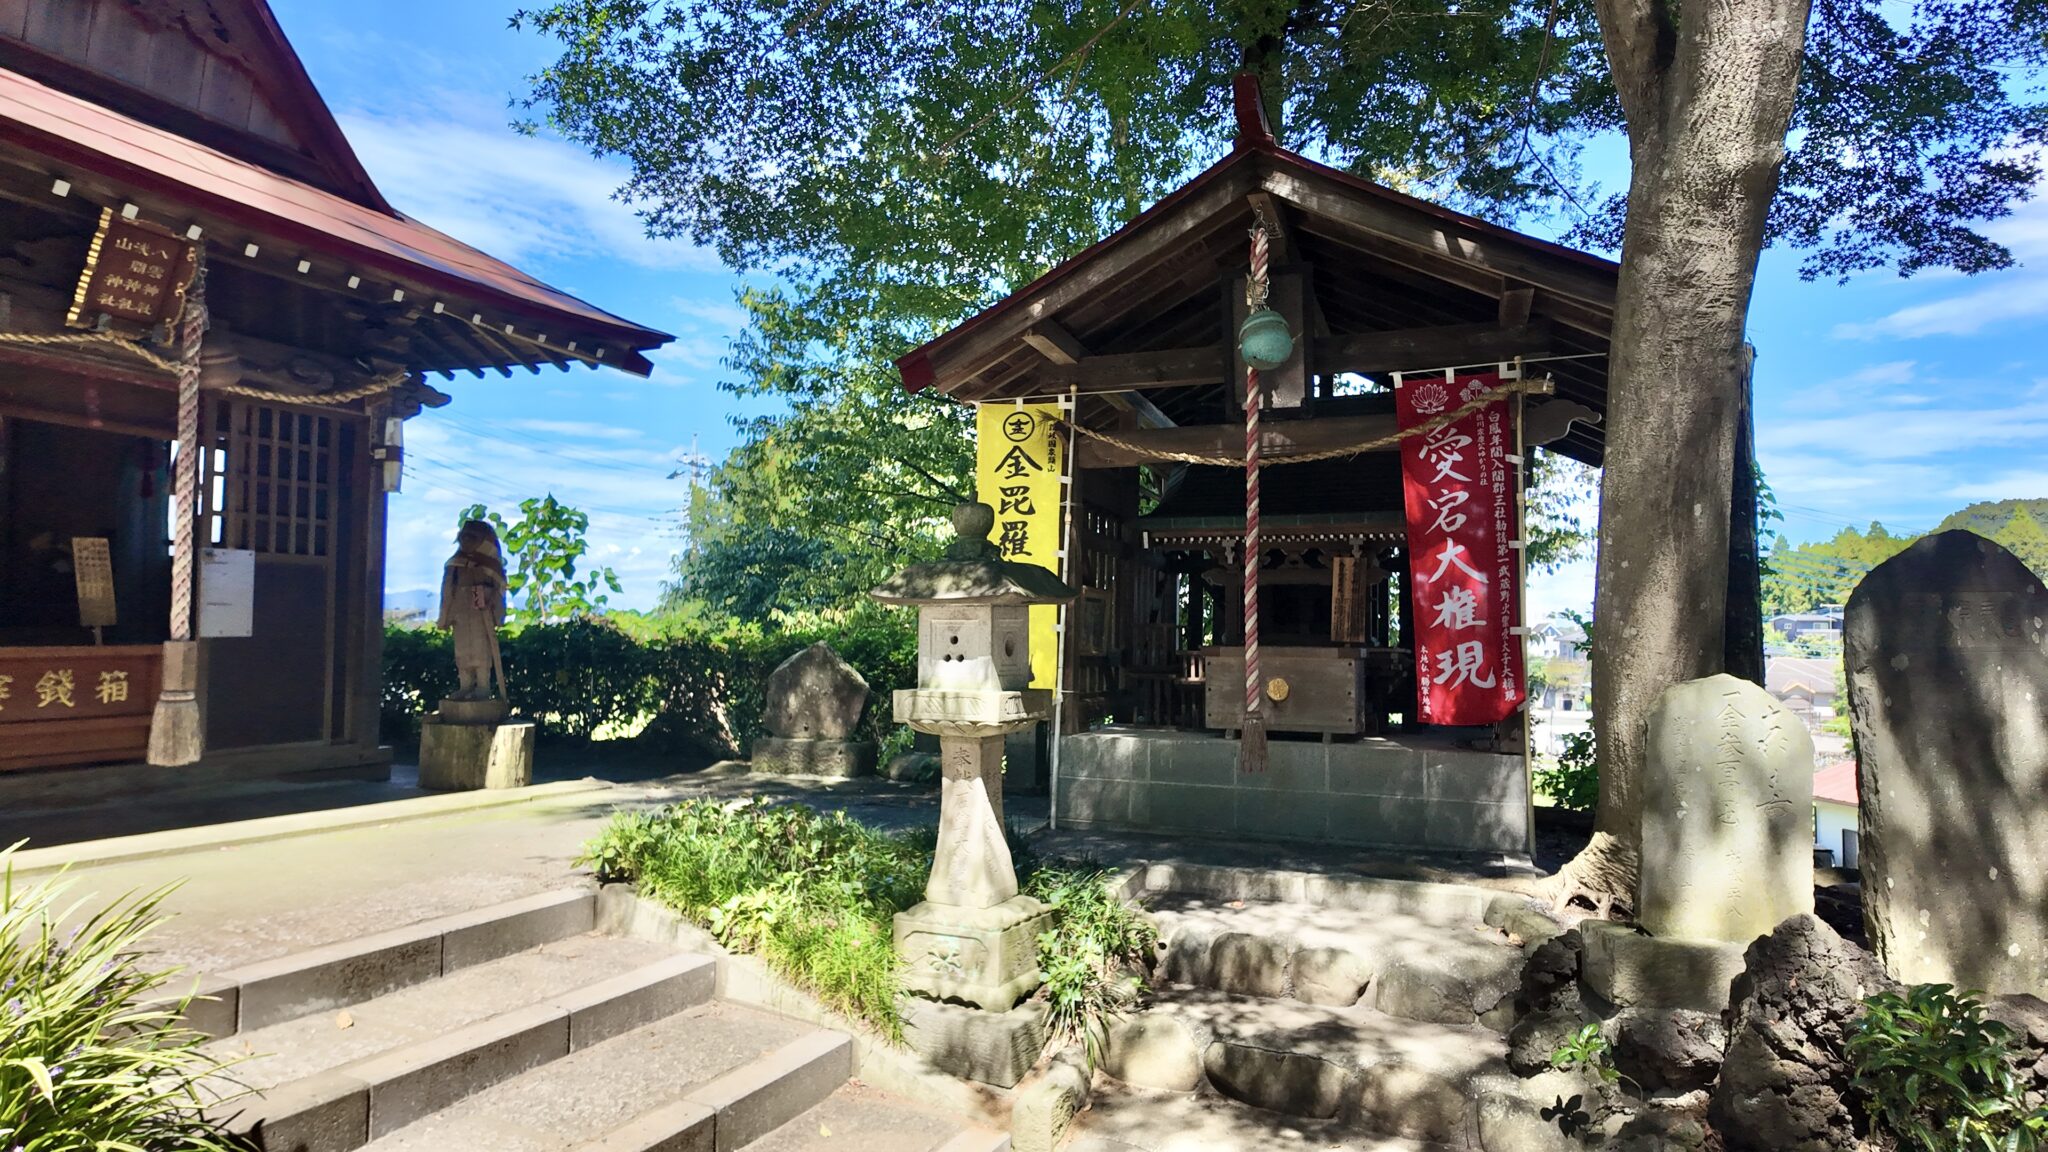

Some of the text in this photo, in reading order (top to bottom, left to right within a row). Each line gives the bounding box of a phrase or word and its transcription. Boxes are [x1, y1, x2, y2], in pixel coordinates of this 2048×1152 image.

[1418, 423, 1496, 690] 愛宕大権現
